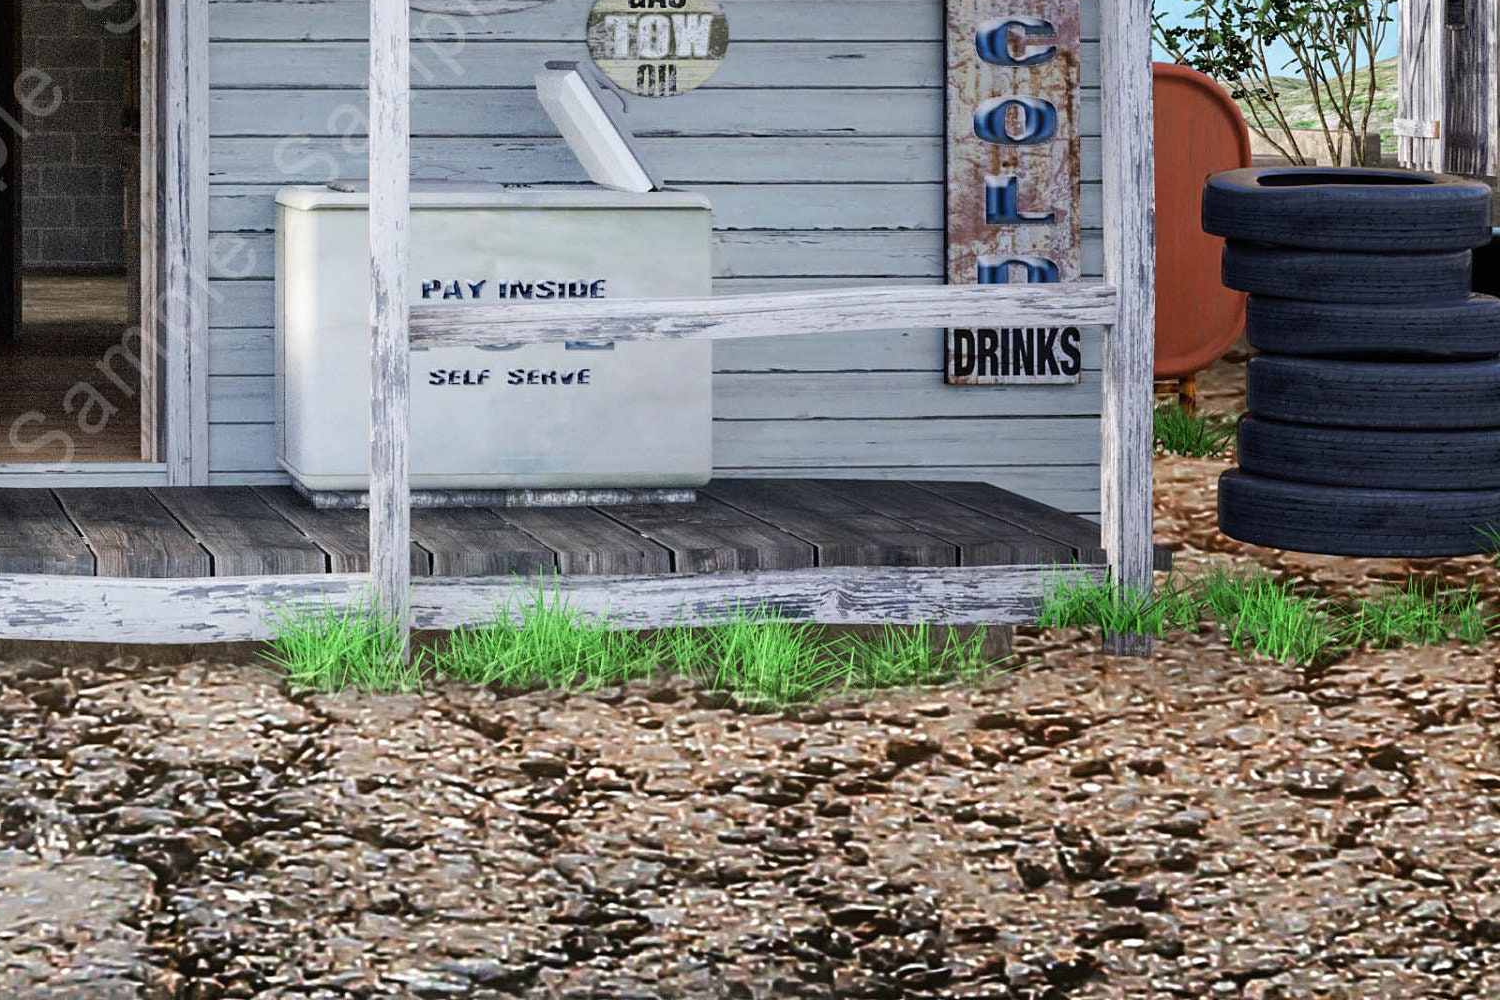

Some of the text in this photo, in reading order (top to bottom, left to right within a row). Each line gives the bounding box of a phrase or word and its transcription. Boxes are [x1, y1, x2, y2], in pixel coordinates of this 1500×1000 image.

[604, 13, 714, 58] TOW
[421, 279, 607, 299] PAY INSIDE
[954, 327, 1081, 376] DRINKS
[429, 368, 591, 385] SELF SERVE
